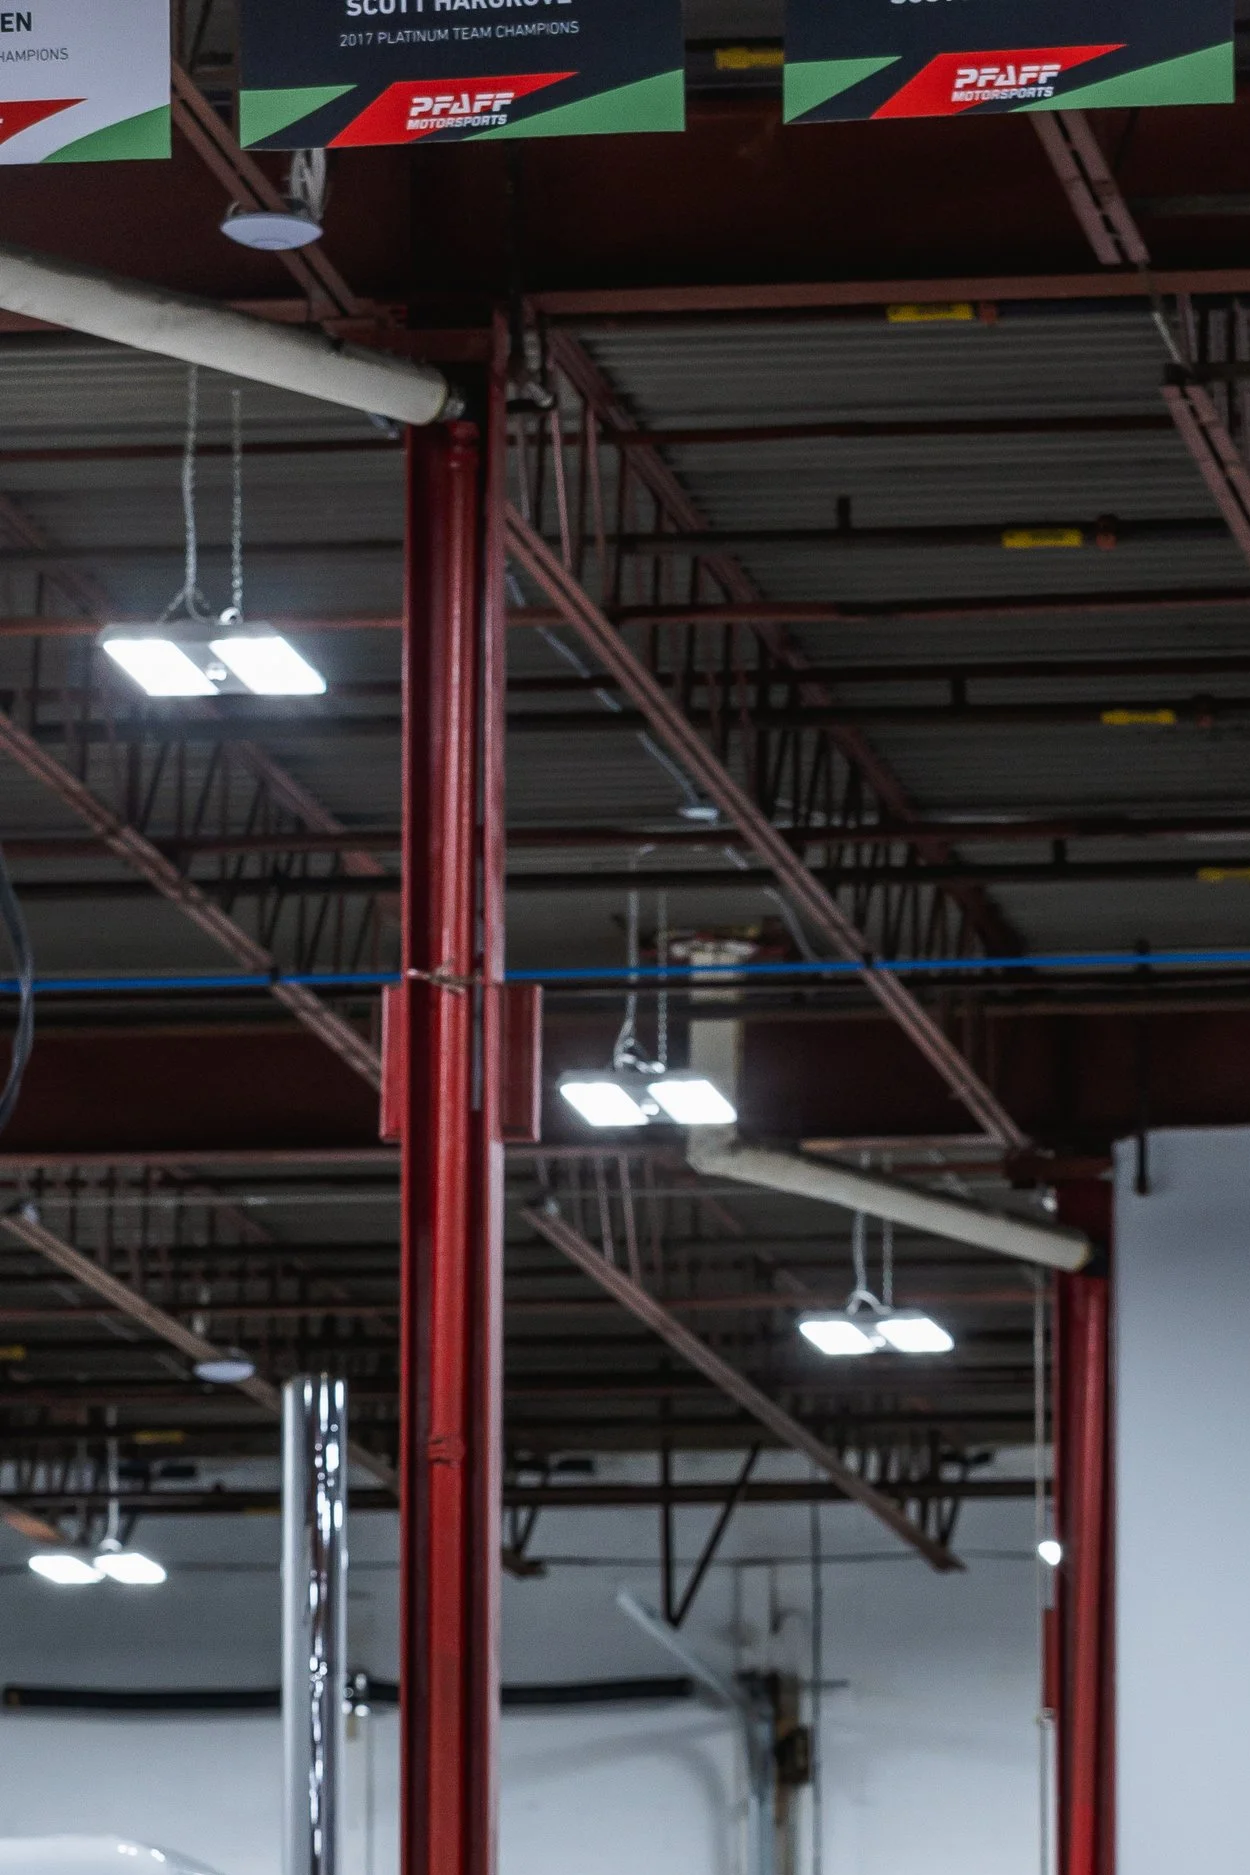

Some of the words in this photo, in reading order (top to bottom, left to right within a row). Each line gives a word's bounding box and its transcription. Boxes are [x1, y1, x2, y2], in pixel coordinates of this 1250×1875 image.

[339, 33, 373, 47] 2017
[377, 29, 449, 44] PLATINUM
[452, 26, 492, 41] TEAM
[494, 20, 580, 38] CHAMPIONS
[954, 64, 1061, 88] PFAFF
[410, 92, 515, 117] PFAFF
[951, 86, 1054, 102] MOTORSPORTS
[406, 114, 508, 131] MOTORSPORTS
